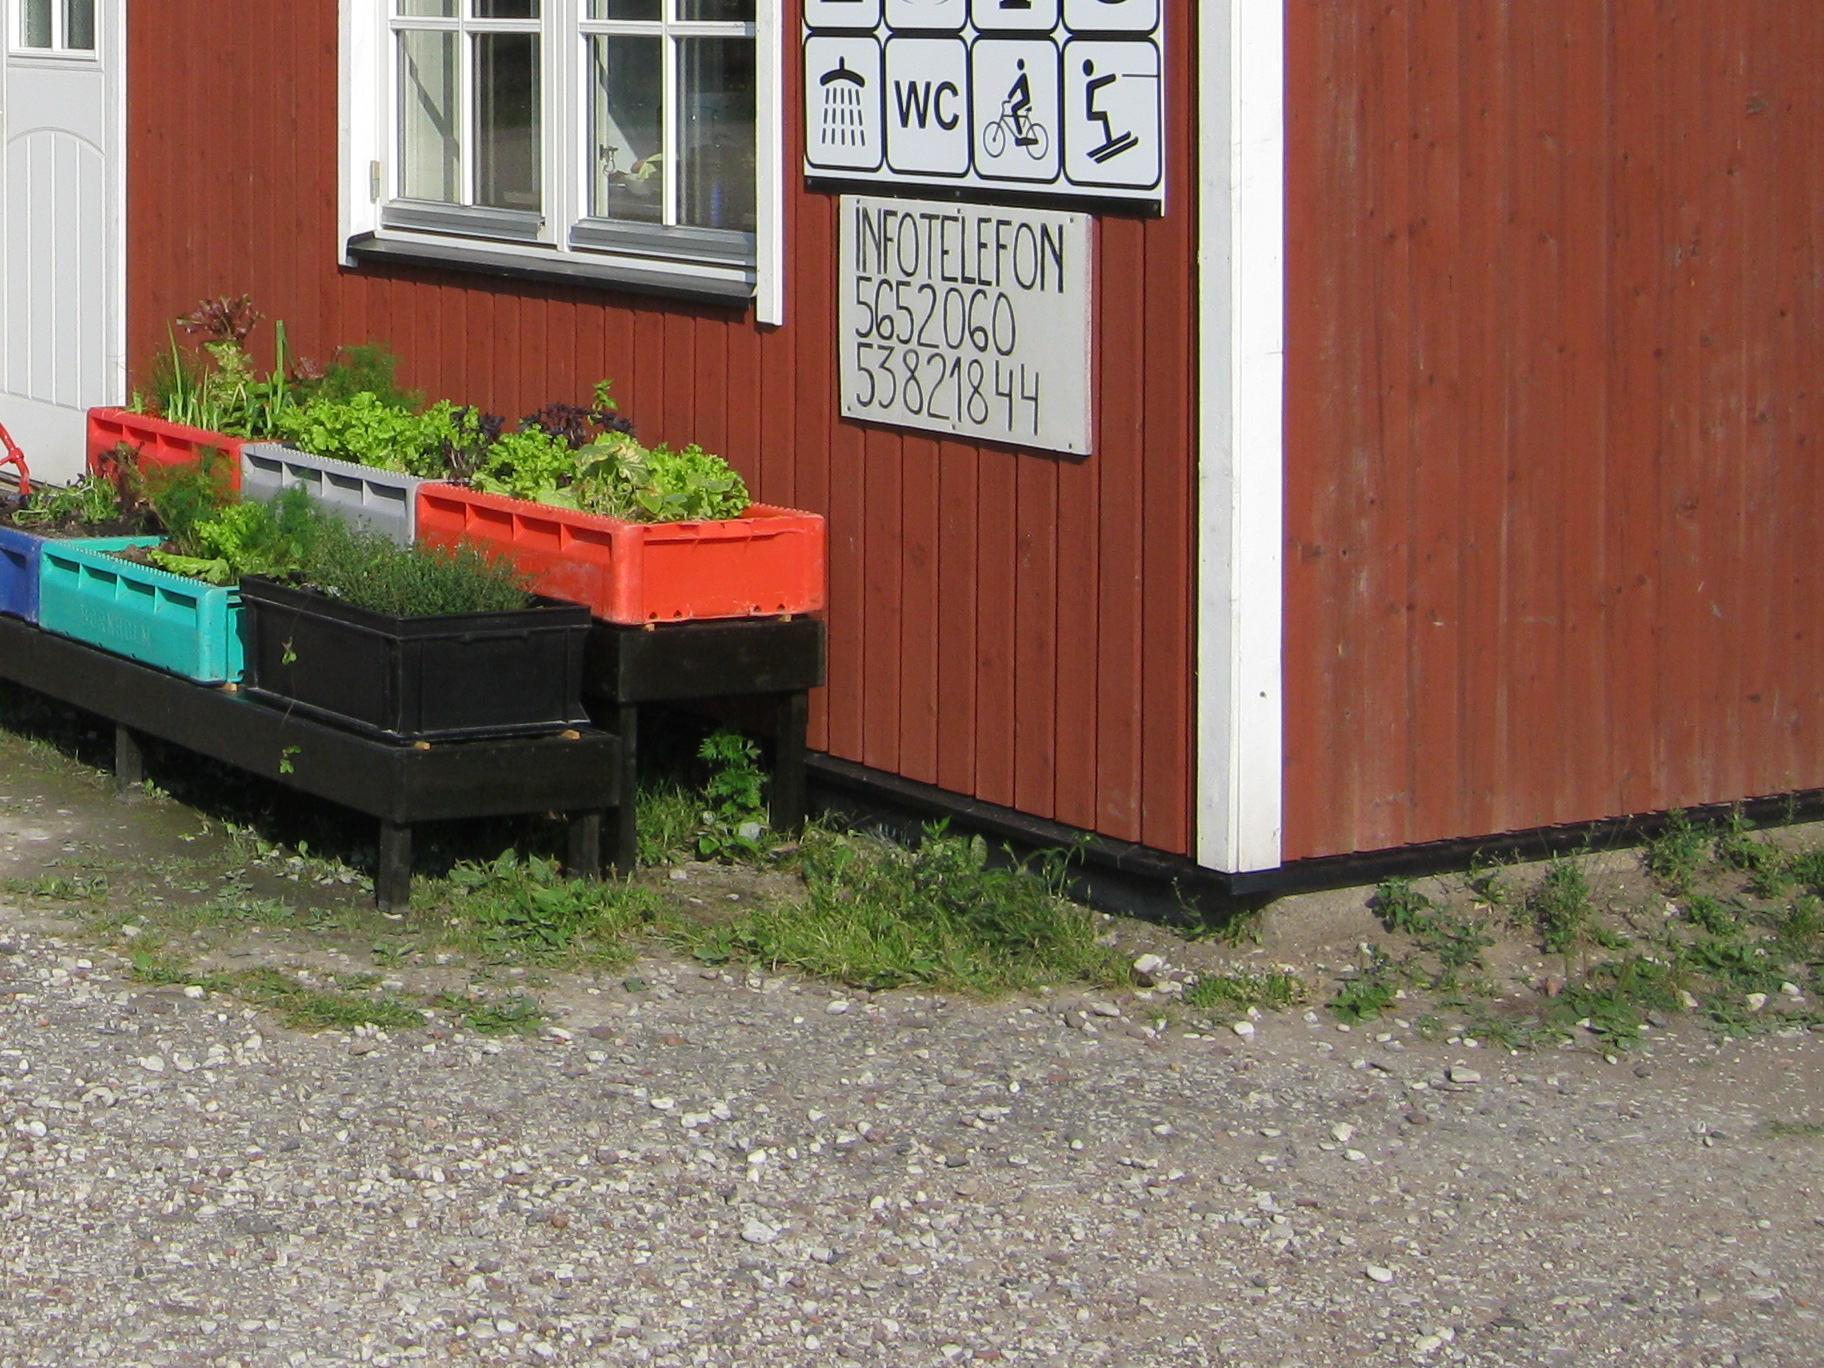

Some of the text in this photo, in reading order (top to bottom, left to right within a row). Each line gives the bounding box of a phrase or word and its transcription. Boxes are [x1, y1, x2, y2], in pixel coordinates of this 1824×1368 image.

[894, 79, 960, 131] WC
[855, 206, 1064, 294] INFOTELEFON
[855, 275, 1016, 356] 5652060
[856, 342, 1039, 436] 53821844
